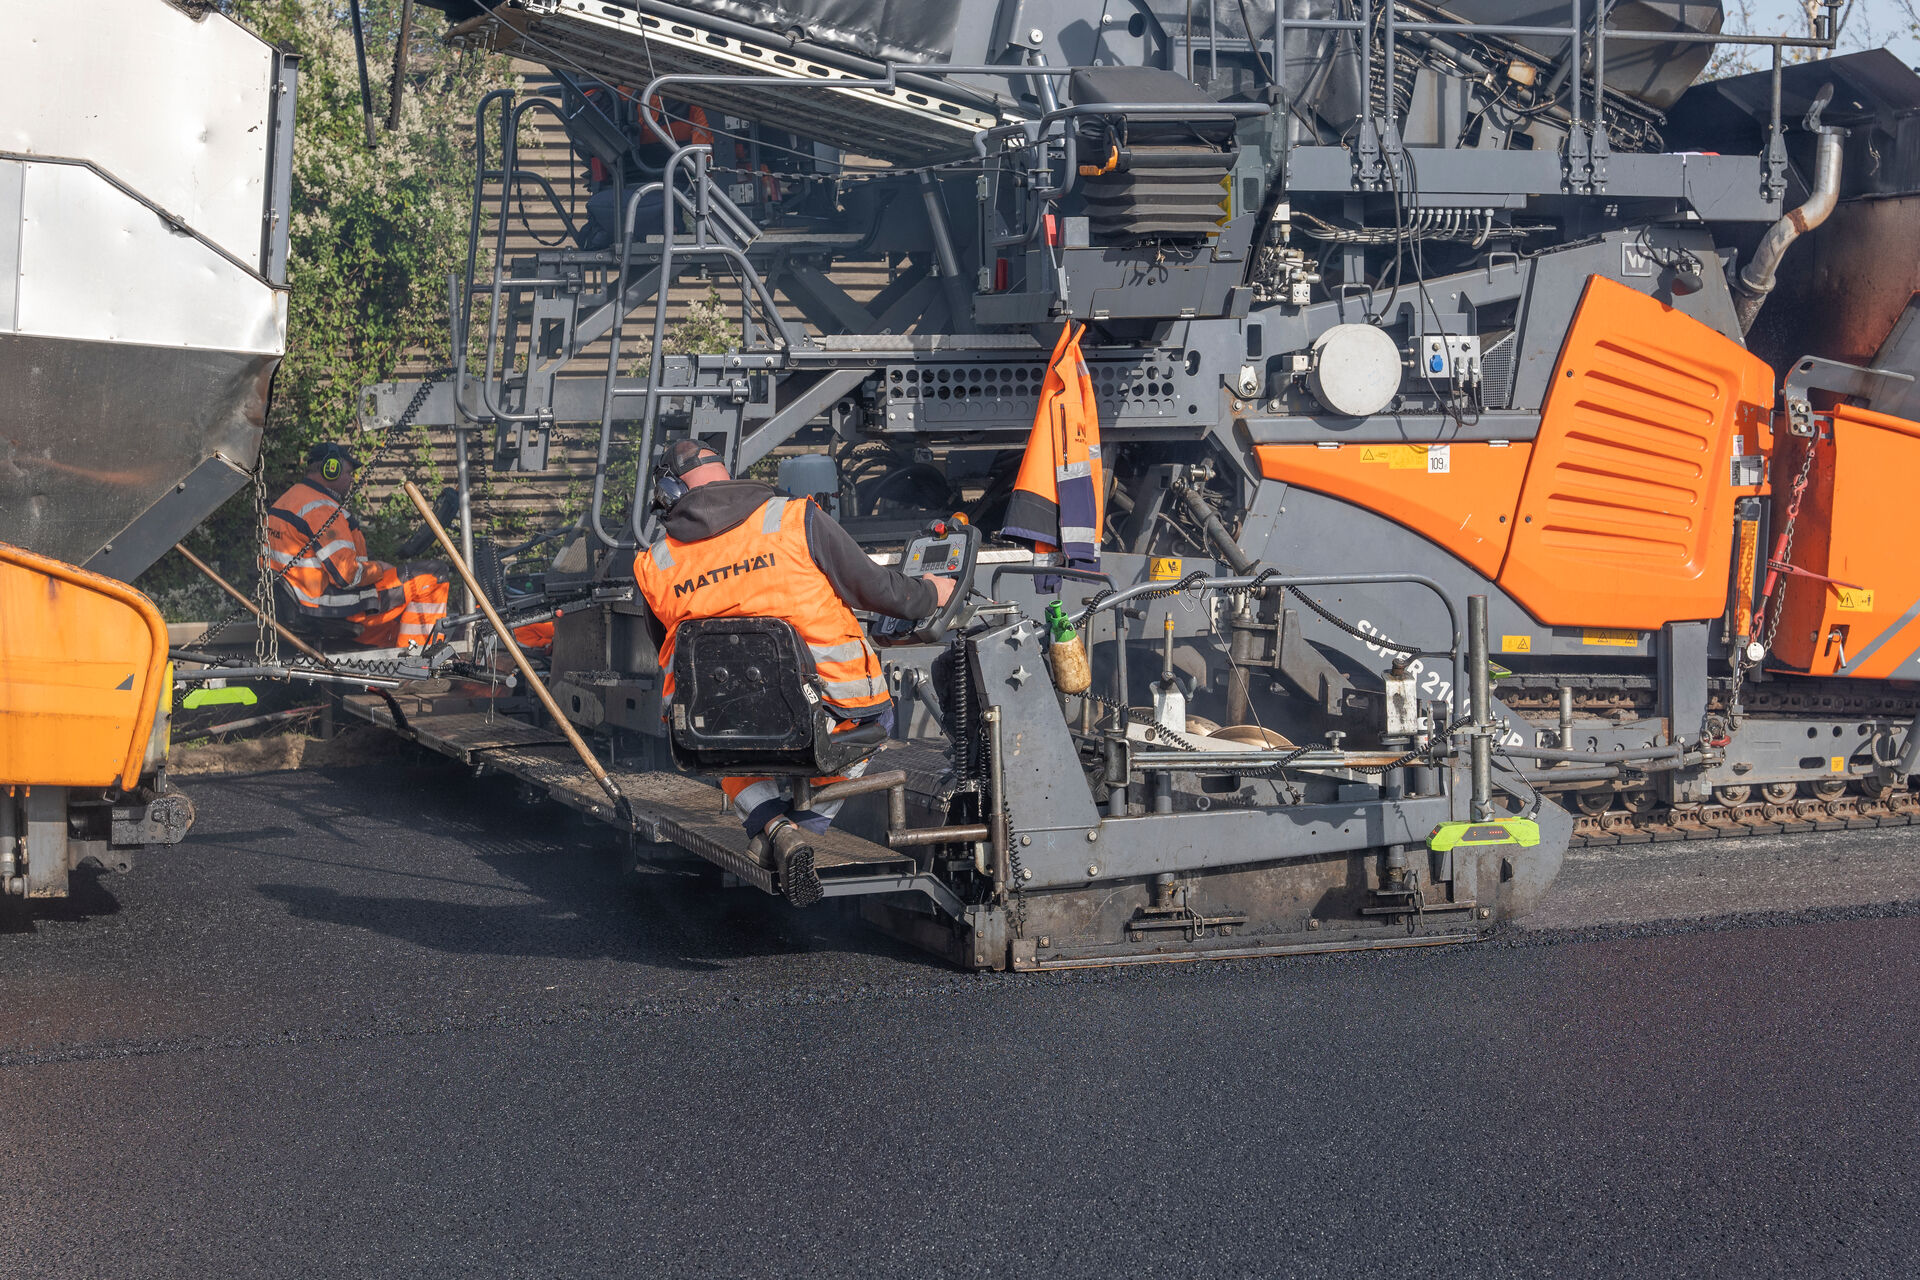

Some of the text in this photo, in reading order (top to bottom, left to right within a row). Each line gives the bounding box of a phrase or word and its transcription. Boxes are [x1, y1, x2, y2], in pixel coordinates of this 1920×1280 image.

[1626, 250, 1649, 269] W
[1430, 457, 1444, 470] 109
[673, 552, 776, 599] MATTHÄI
